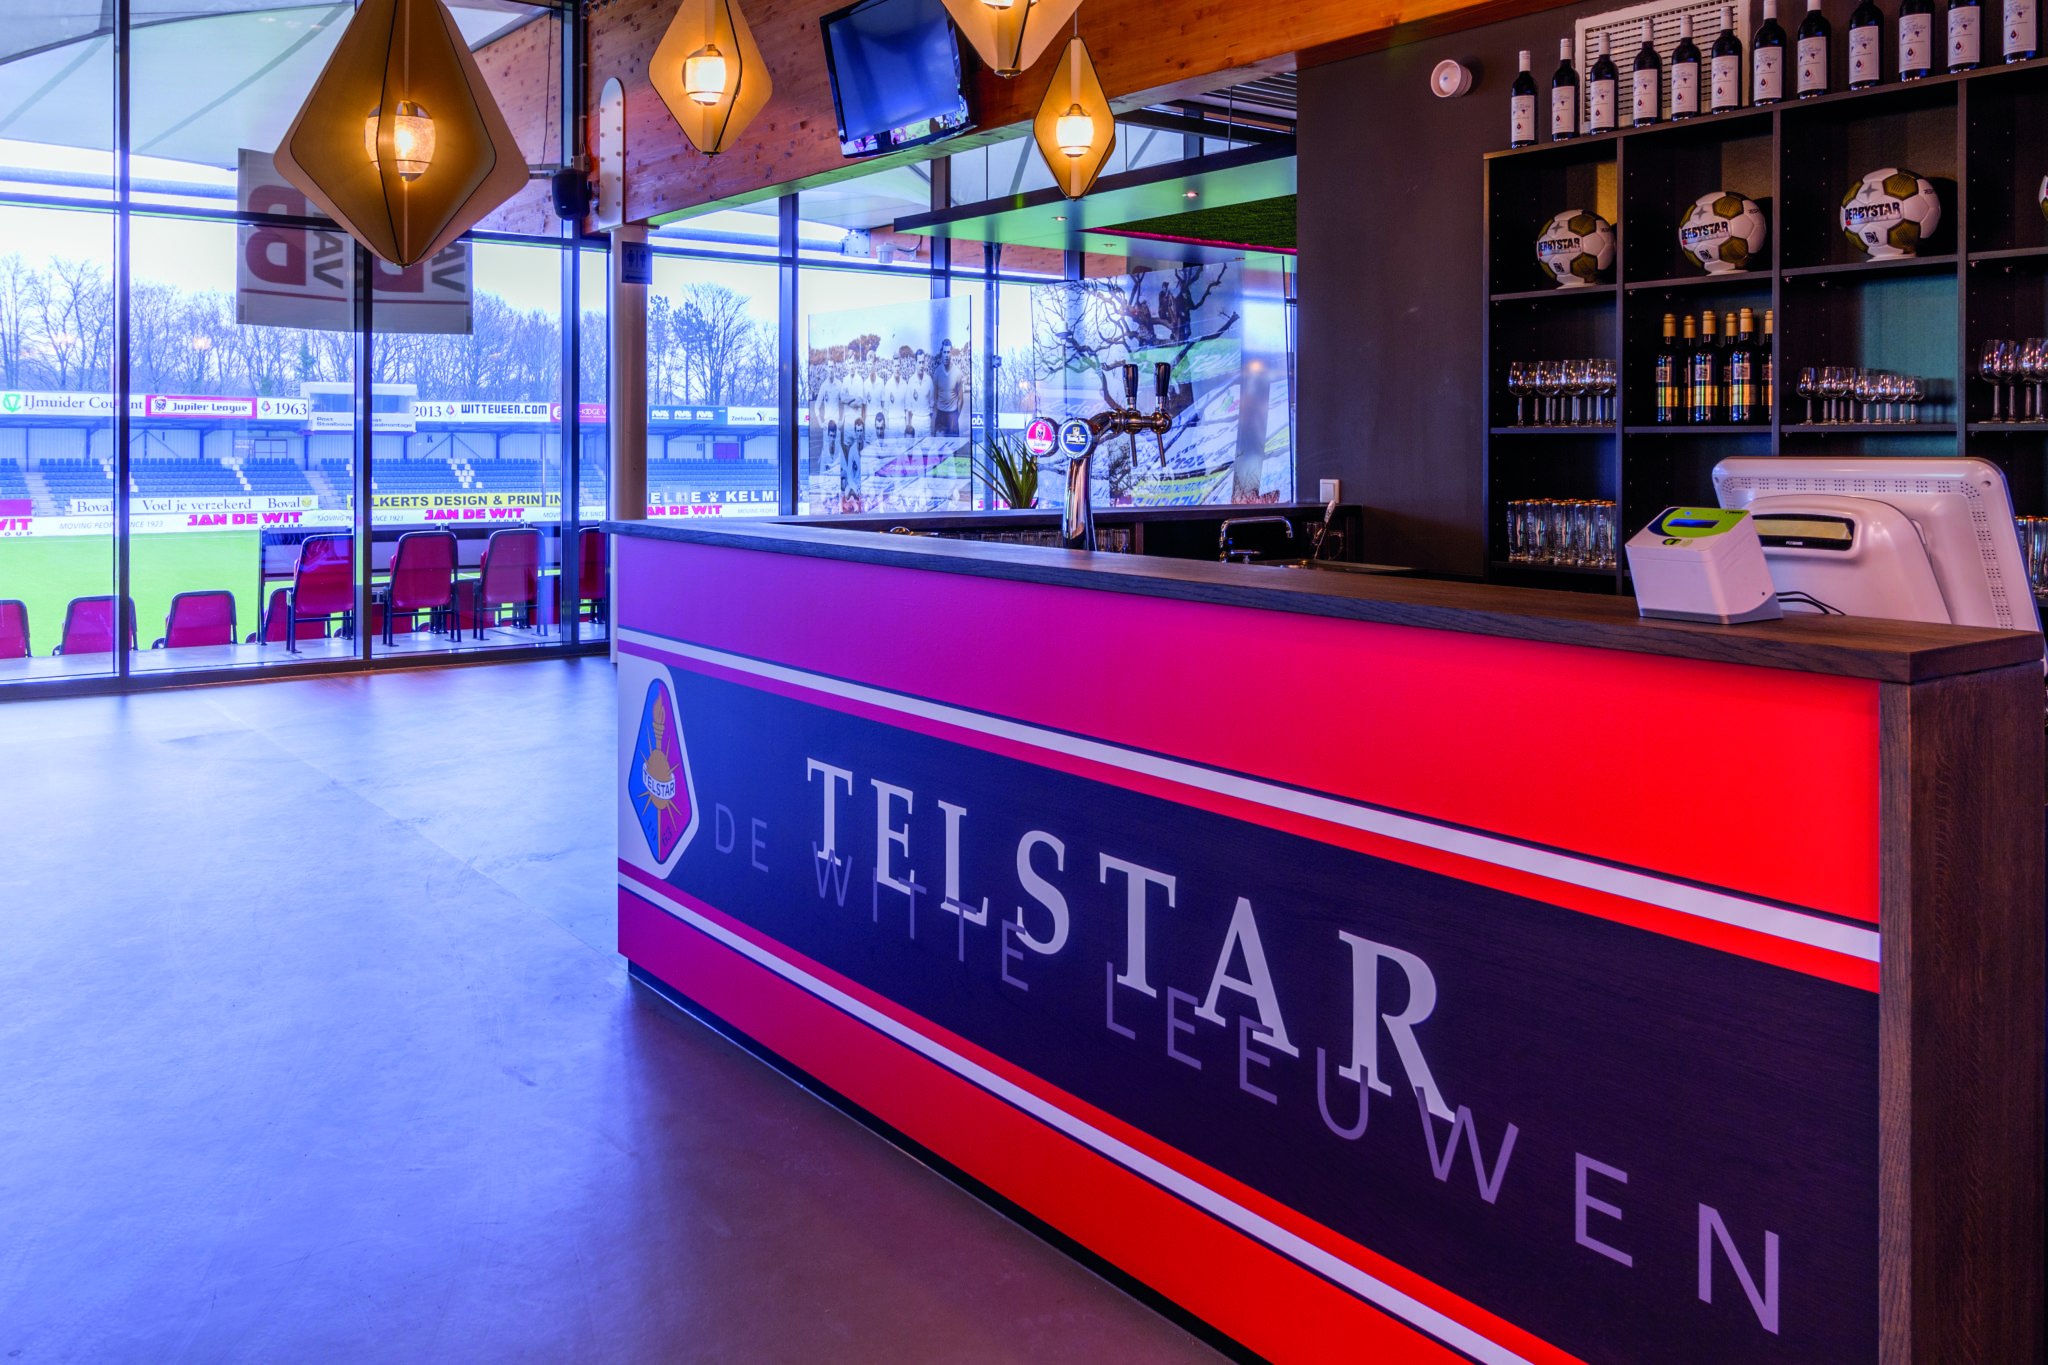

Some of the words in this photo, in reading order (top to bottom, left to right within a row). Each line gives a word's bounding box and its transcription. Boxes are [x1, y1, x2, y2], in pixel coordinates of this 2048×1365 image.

[1845, 201, 1900, 221] DERBYSTAR
[1681, 221, 1729, 240] DERBYSTAR
[1538, 237, 1580, 252] DERBYSTAR
[25, 394, 84, 410] IJmuider
[89, 396, 143, 410] Count
[171, 400, 209, 412] Jupiler
[211, 402, 248, 413] League
[275, 402, 307, 416] 1963
[414, 405, 442, 418] 2013
[142, 499, 172, 511] Voel
[175, 500, 187, 512] je
[191, 498, 252, 510] verzekerd
[268, 497, 300, 509] Boval
[434, 495, 488, 506] DESIGN
[493, 495, 503, 505] &
[651, 491, 701, 504] ELME
[424, 509, 459, 520] JAN
[463, 508, 486, 520] DE
[489, 508, 525, 519] WIT
[647, 506, 666, 516] AN
[669, 505, 689, 515] DE
[692, 505, 723, 515] WIT
[59, 521, 93, 530] MOVING
[147, 519, 164, 528] 1923
[187, 513, 227, 526] JAN
[232, 512, 258, 525] DE
[262, 511, 303, 524] WIT
[643, 769, 675, 797] TELSTAR
[807, 757, 1456, 1123] TELSTAR
[715, 801, 769, 873] DE
[812, 841, 1029, 992] WITTE
[1106, 961, 1779, 1336] LEEUWEN
